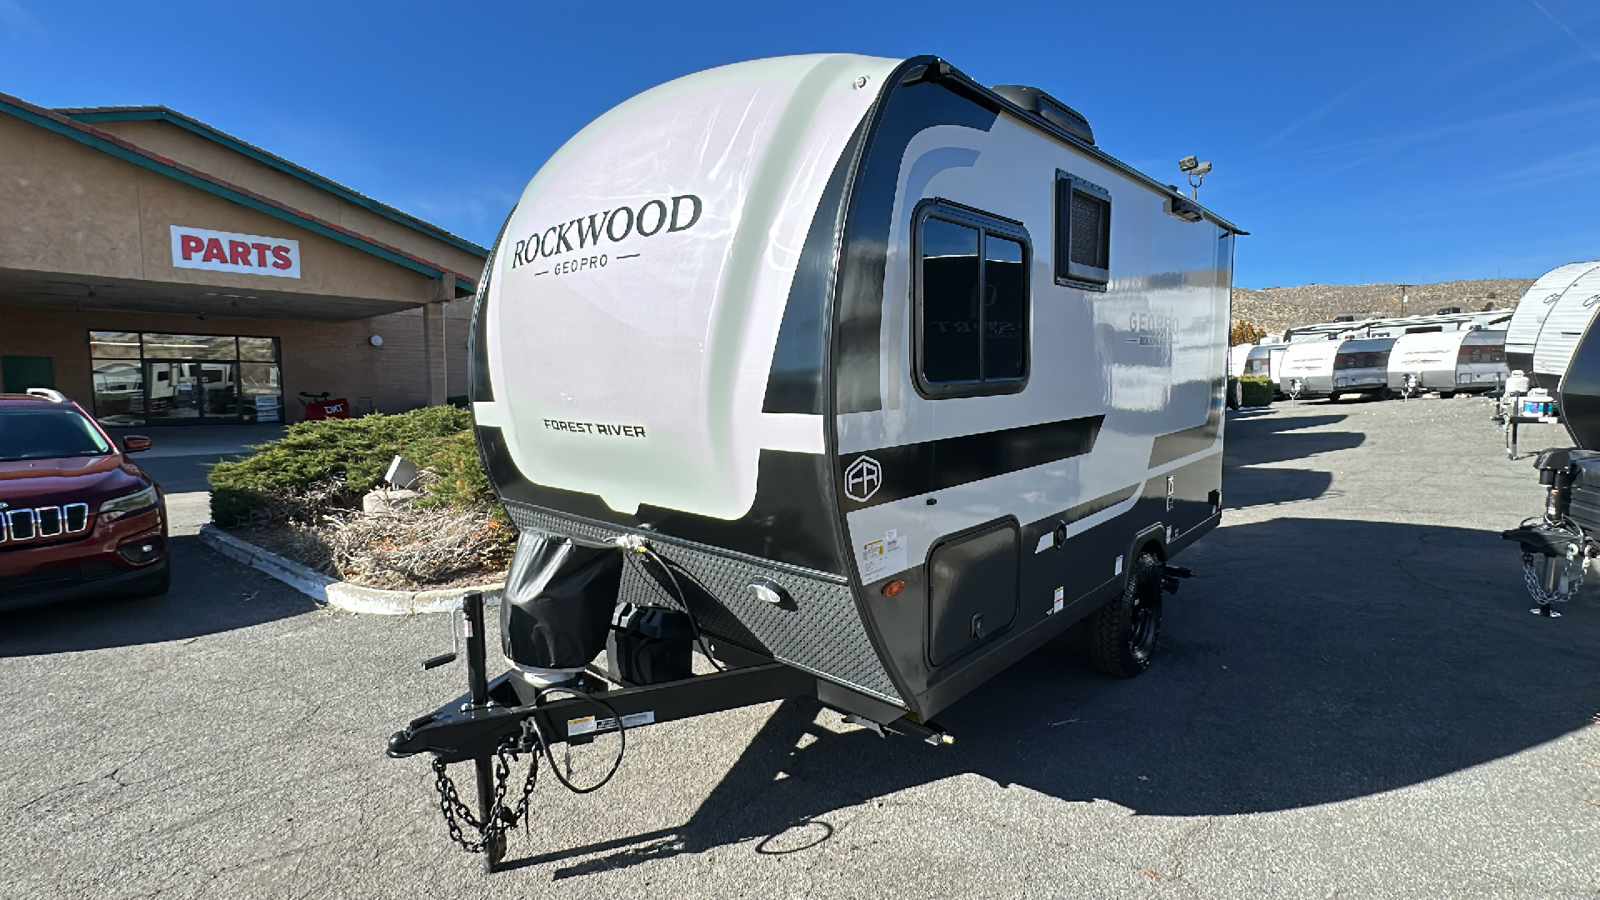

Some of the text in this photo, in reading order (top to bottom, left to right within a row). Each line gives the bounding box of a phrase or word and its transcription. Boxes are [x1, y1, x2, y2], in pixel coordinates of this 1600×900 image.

[511, 194, 703, 270] ROCKWOOD
[181, 234, 293, 270] PARTS
[554, 253, 609, 276] GEOPRO
[1129, 311, 1179, 335] GEOPRO
[543, 418, 647, 438] FOREST RIVER
